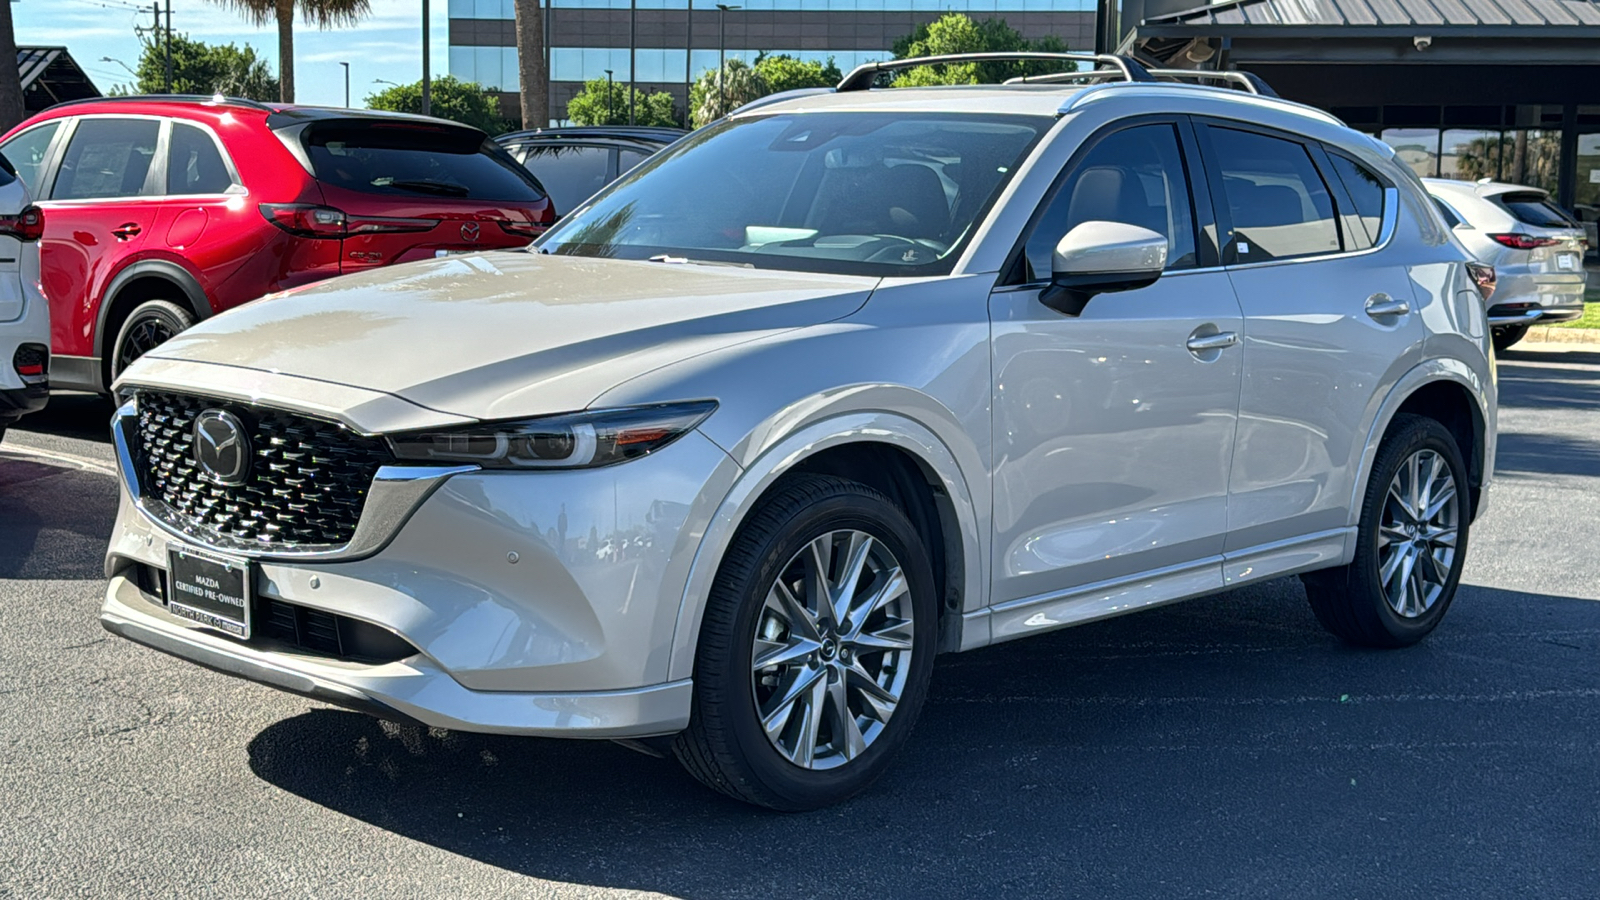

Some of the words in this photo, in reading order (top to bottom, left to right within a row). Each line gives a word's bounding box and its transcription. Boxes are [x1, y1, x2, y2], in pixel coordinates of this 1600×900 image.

[195, 575, 220, 590] MAZDA
[175, 580, 204, 597] CERTIFIED
[204, 589, 245, 608] PRE-OWNED
[172, 604, 195, 619] NORTH
[195, 611, 214, 626] PARK
